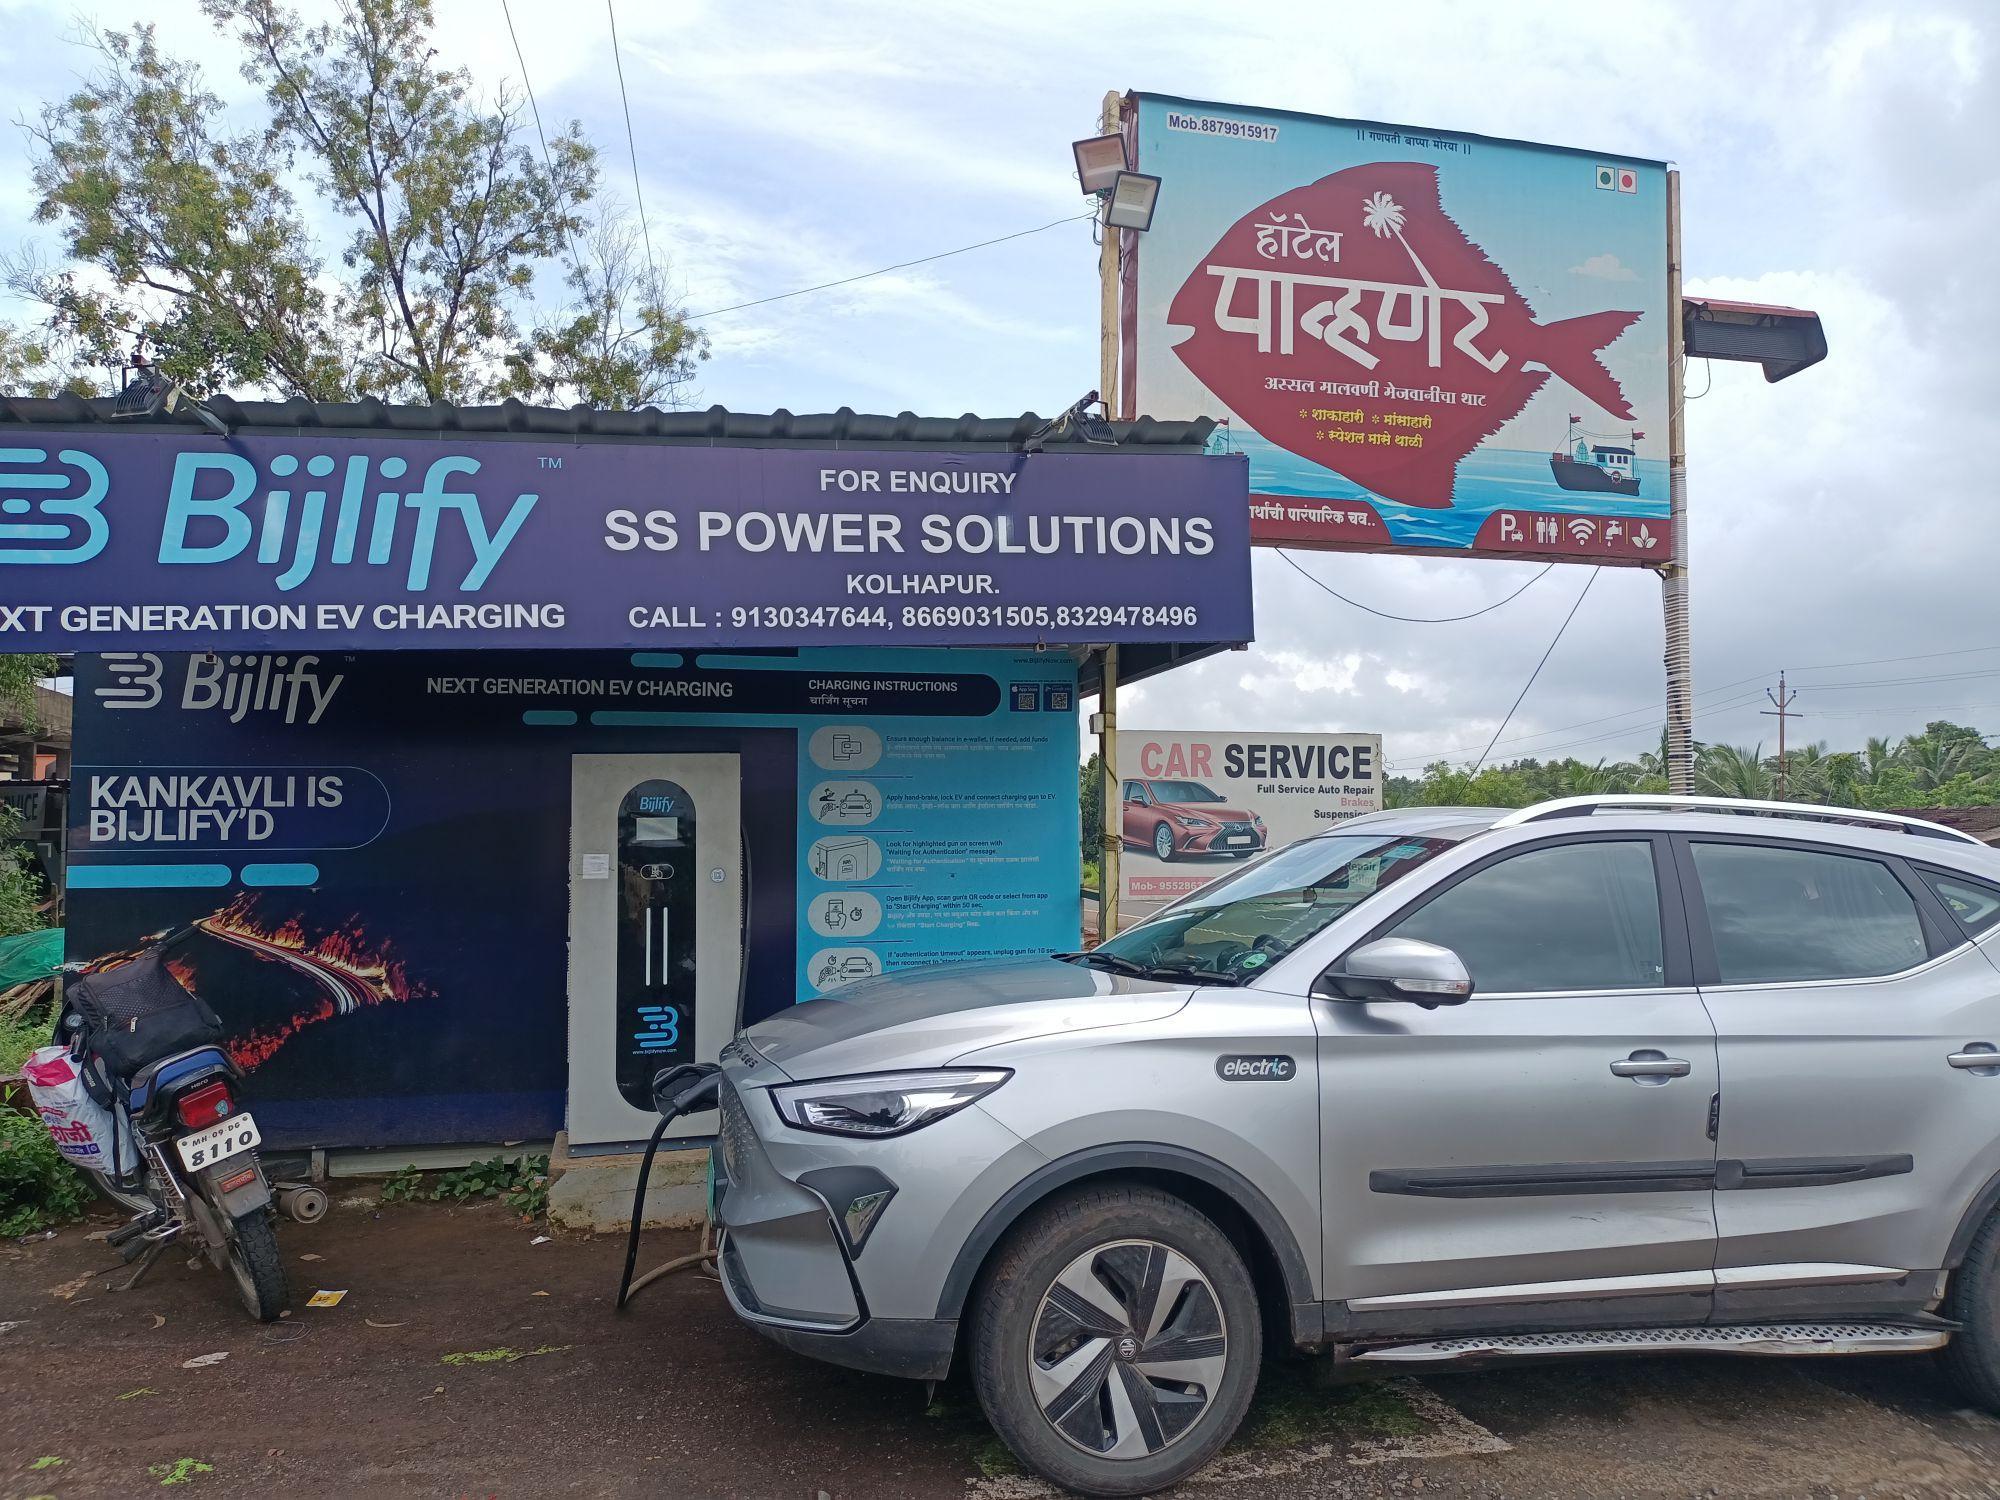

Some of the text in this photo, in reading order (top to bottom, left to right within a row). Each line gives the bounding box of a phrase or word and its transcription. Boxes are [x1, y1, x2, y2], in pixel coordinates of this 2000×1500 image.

[1169, 115, 1276, 140] Mob.8879915917
[1369, 132, 1400, 144] गणपती
[1404, 136, 1429, 148] बाप्पा
[1433, 137, 1457, 152] मोरया
[1255, 211, 1343, 262] हॉटेल
[1265, 377, 1487, 407] अस्सल मालवणी मेजवानीचा थाट
[1312, 409, 1432, 429] शाकाहारी मांसाहारी
[1329, 428, 1423, 448] स्पेशल मासे थाळी
[821, 469, 1017, 495] FOR ENQUIRY
[158, 452, 562, 591] Bijlify TM
[1288, 504, 1344, 524] पारंपारिक
[604, 510, 1215, 556] SS POWER SOLUTIONS
[846, 573, 1000, 595] KOLHAPUR.
[60, 604, 306, 632] GENERATION
[317, 604, 365, 630] EV
[372, 603, 566, 630] CHARGING
[628, 606, 705, 629] CALL
[731, 606, 894, 632] 9130347644,
[181, 653, 344, 724] Bijlify
[427, 677, 733, 697] NEXT GENERATION EV CHARGING
[809, 680, 958, 691] CHARGING INSTRUCTIONS
[842, 697, 868, 708] सूचना
[1140, 742, 1372, 780] CAR SERVICE
[91, 776, 343, 808] KANKAVLI IS
[1257, 784, 1374, 796] Full Service Auto Repair
[639, 796, 674, 813] Bijlify
[1340, 797, 1374, 807] Brakes
[912, 840, 946, 848] highlighted
[1131, 882, 1156, 890] Mob-
[1223, 1057, 1288, 1077] electric
[192, 1131, 252, 1166] 8110
